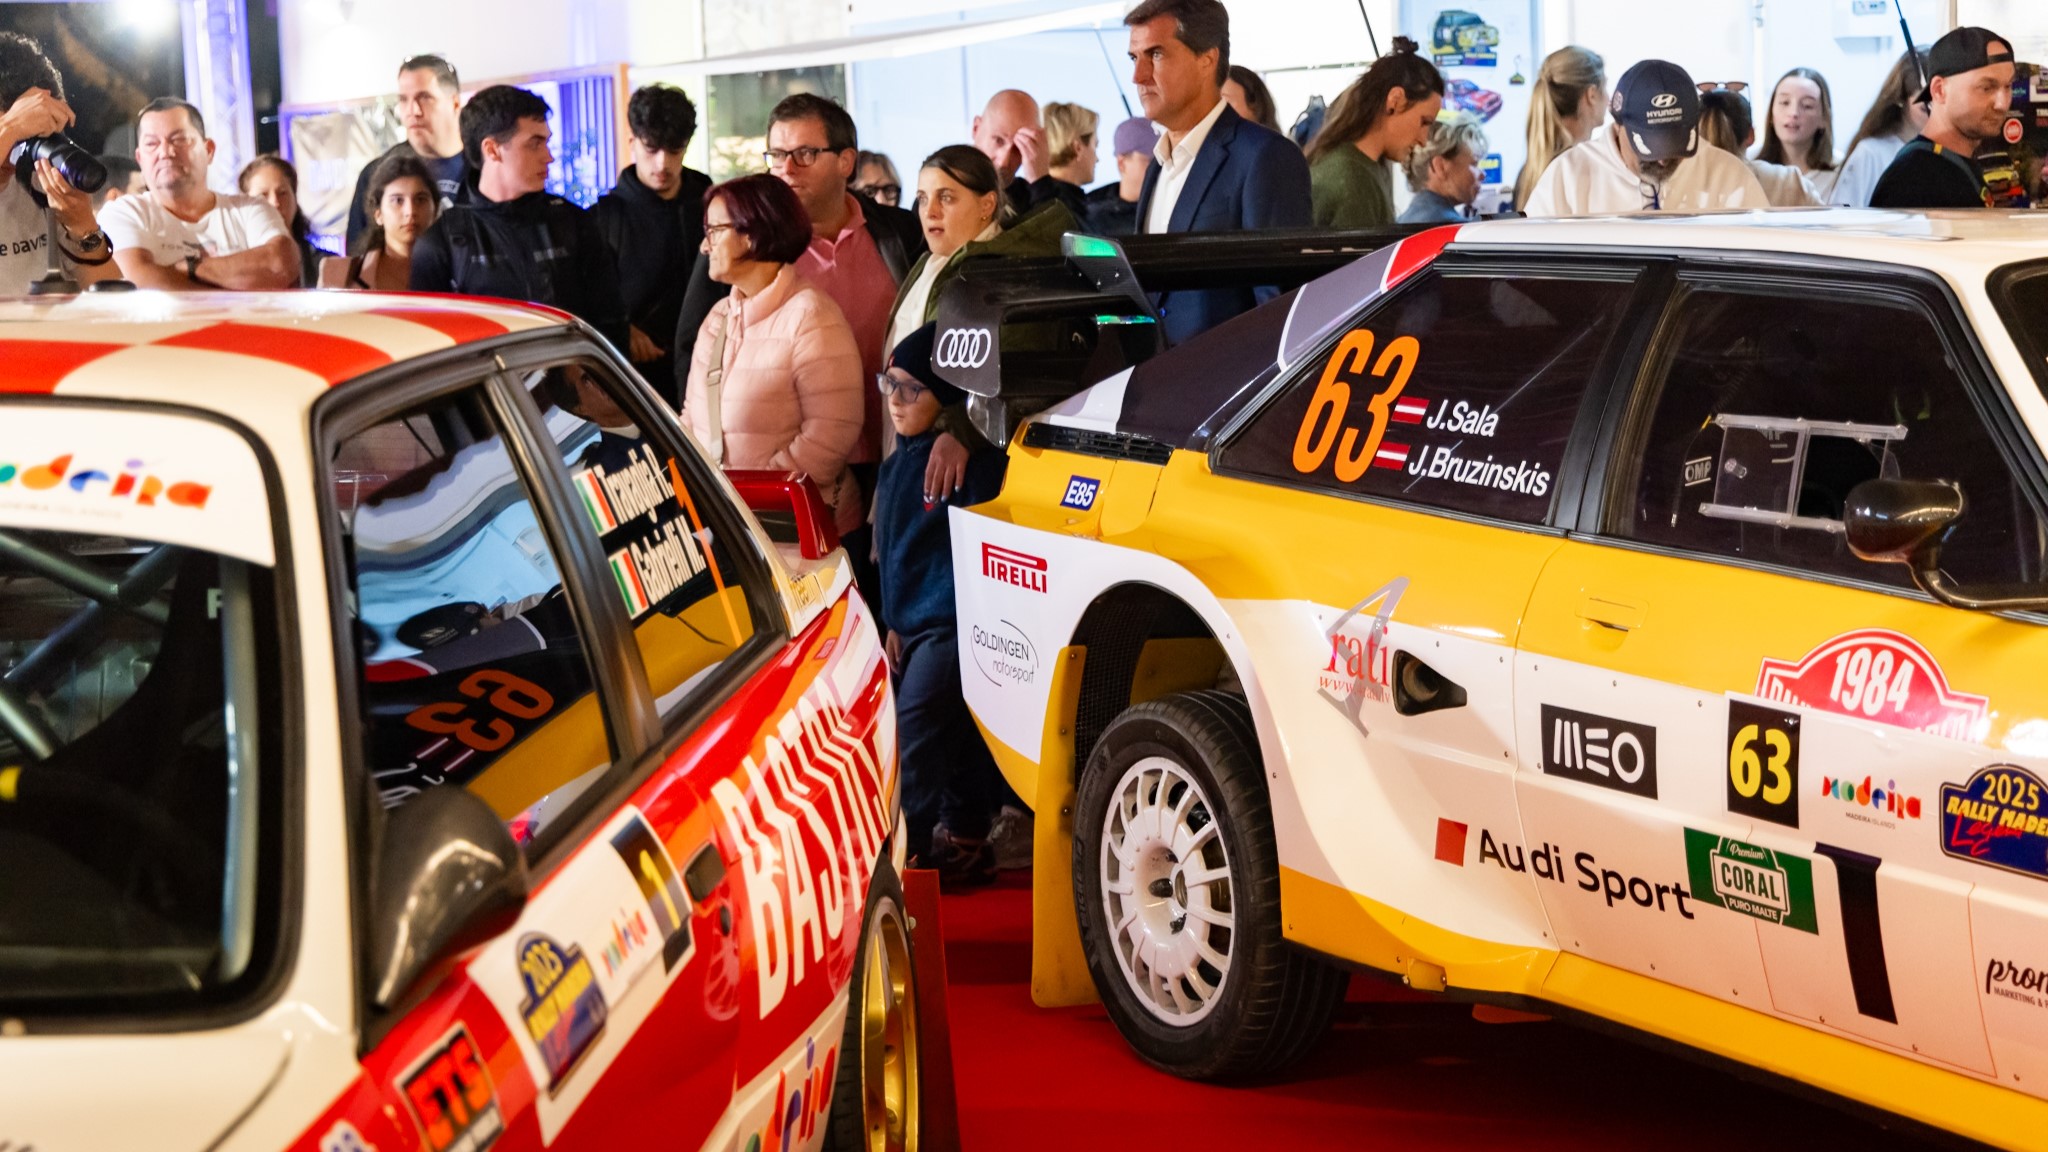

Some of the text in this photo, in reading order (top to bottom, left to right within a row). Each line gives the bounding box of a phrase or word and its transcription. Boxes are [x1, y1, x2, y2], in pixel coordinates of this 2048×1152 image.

[1646, 108, 1683, 118] HYUNDAI
[1292, 329, 1420, 483] 63
[1426, 399, 1499, 437] J.Sala
[593, 443, 675, 523] Travaglia R.
[1408, 445, 1551, 497] J.Bruzinskis
[1684, 460, 1711, 482] OMP
[1064, 480, 1096, 507] E85
[630, 514, 707, 605] Gabrielli M.
[982, 542, 1048, 594] PIRELLI
[973, 625, 1029, 661] GOLDINGEN
[993, 656, 1034, 684] motorsport
[1829, 648, 1915, 716] 1984
[1553, 718, 1645, 783] MEO
[1730, 724, 1792, 805] 63
[1946, 796, 1999, 823] RALLY
[1983, 773, 2040, 811] 2025
[1845, 811, 1896, 831] MADEIRA ISLANDS
[1729, 843, 1765, 860] Premium
[1479, 828, 1695, 920] Audi Sport
[1721, 862, 1780, 902] CORAL
[1729, 899, 1778, 921] PURO MALTE
[1994, 986, 2035, 1006] MARKETING
